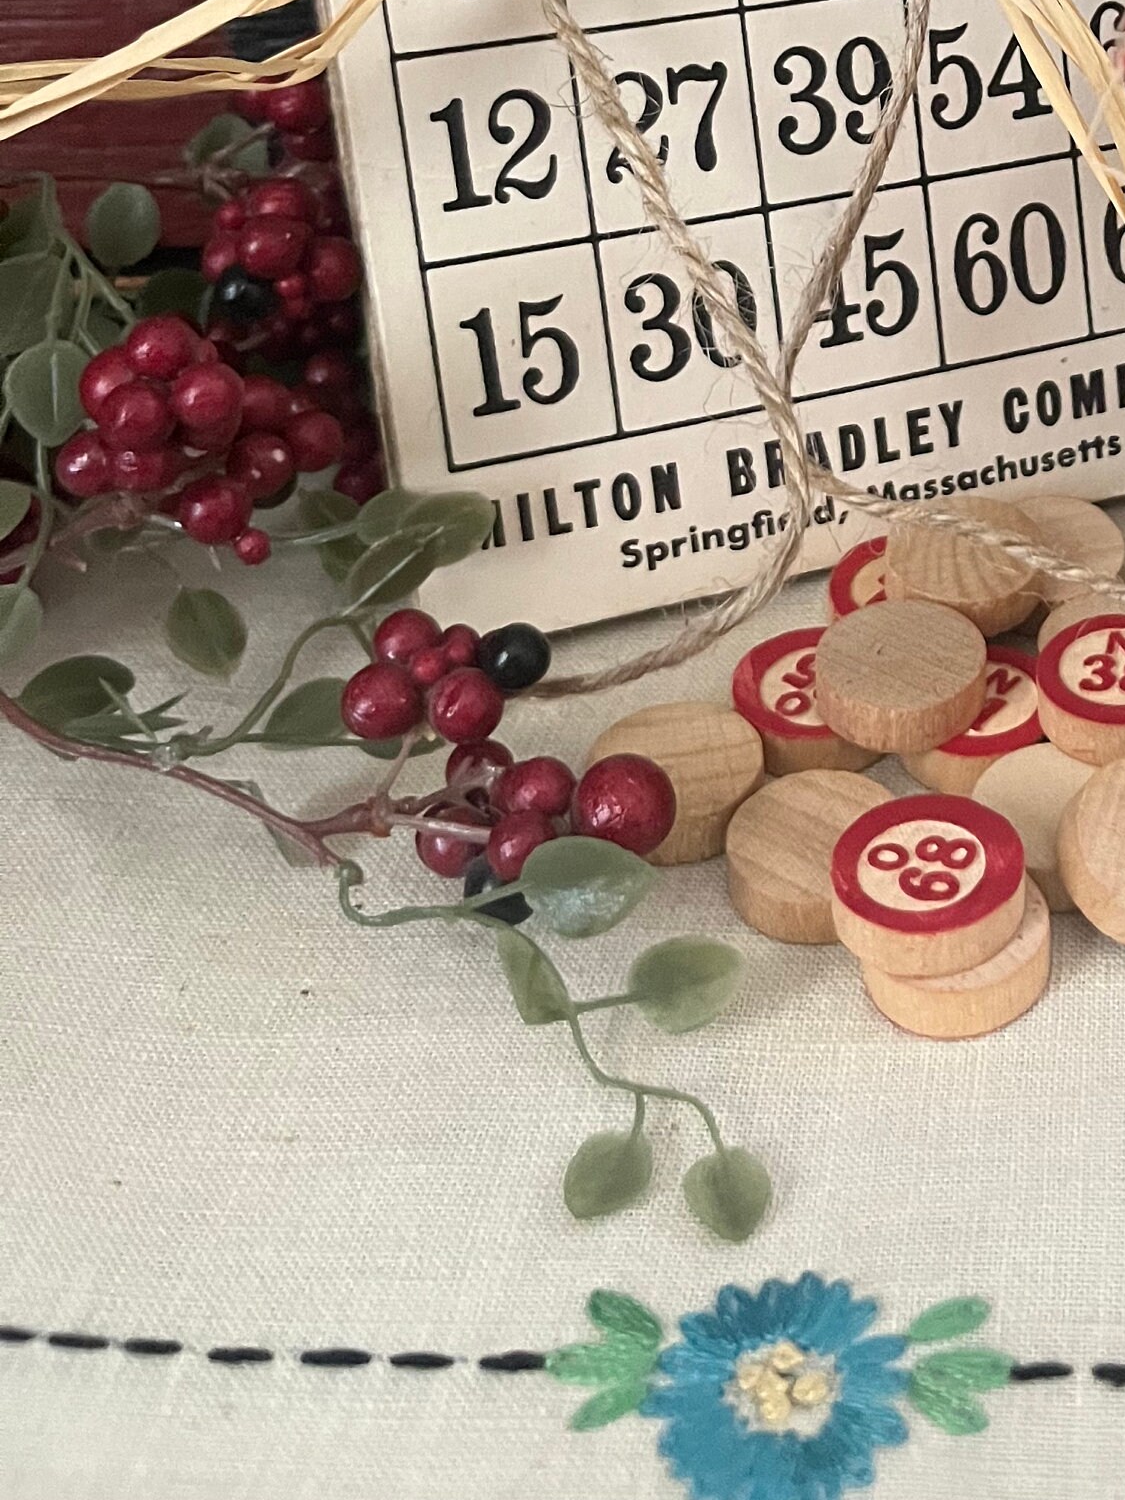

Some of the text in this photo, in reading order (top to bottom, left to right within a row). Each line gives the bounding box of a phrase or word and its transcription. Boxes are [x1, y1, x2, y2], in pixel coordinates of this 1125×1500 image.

[429, 97, 558, 213] 12
[773, 36, 892, 156] 39
[928, 22, 1054, 131] 54
[459, 293, 580, 417] 15
[623, 259, 758, 382] 30
[953, 201, 1067, 316] 60
